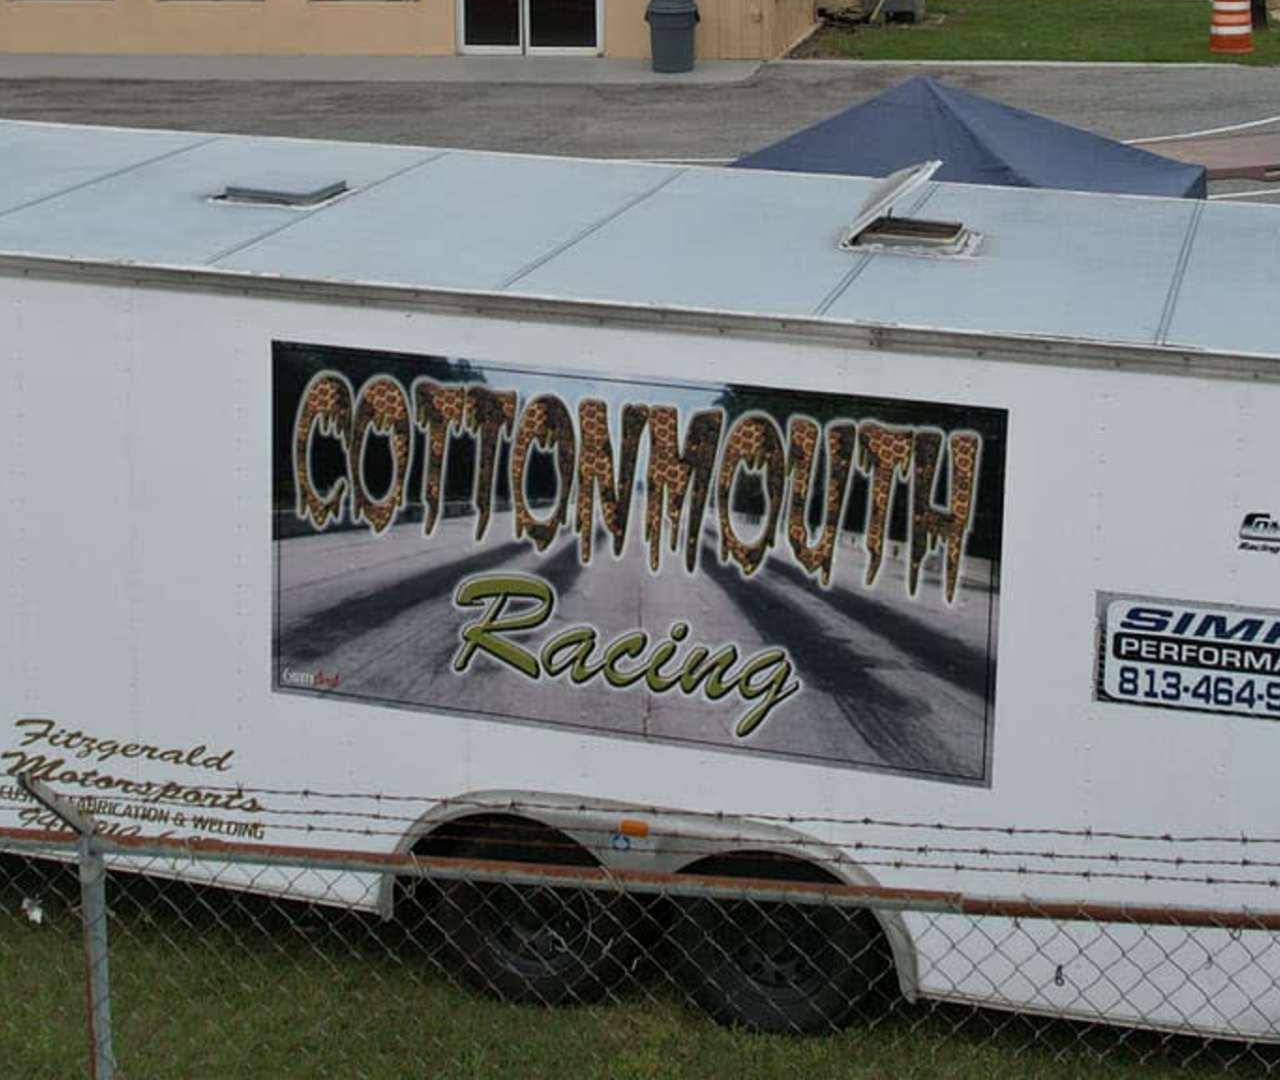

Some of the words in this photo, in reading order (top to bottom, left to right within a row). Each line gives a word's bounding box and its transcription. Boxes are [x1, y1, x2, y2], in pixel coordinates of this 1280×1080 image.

[295, 371, 982, 605] COTTONMOUTH
[451, 572, 802, 739] Racing
[14, 718, 235, 771] Fitzgerald
[0, 750, 264, 813] Motorsports
[172, 811, 186, 828] &
[192, 814, 265, 841] WELDING
